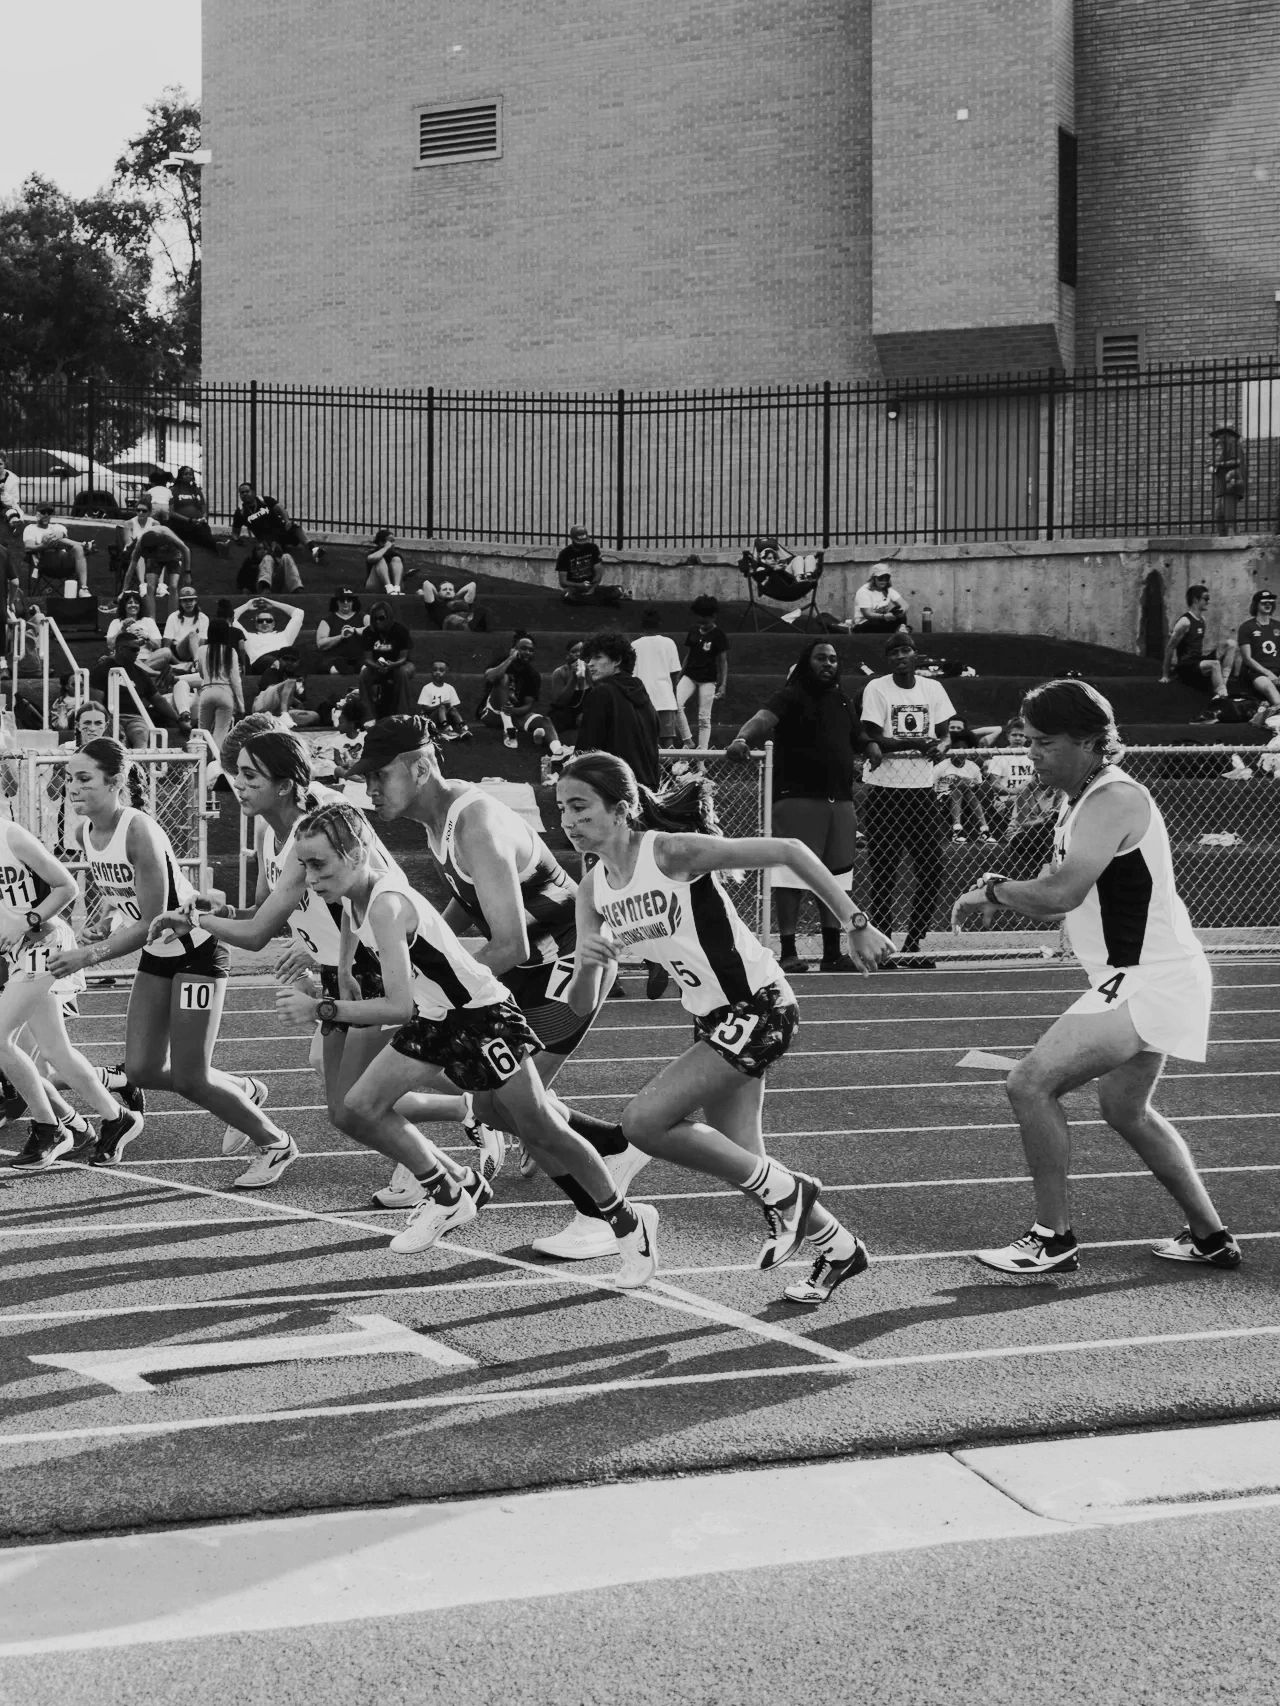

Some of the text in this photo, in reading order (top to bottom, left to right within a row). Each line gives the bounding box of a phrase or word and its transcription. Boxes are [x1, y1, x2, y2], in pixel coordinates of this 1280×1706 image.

[4, 880, 30, 907] 11
[117, 901, 142, 921] 10
[601, 889, 668, 928] ELEVATED
[296, 927, 319, 954] 8
[28, 948, 50, 972] 11
[670, 960, 702, 988] 5
[553, 963, 573, 998] 7
[1097, 971, 1126, 1004] 4
[183, 983, 210, 1009] 10
[718, 1013, 754, 1046] 5
[487, 1041, 516, 1075] 6
